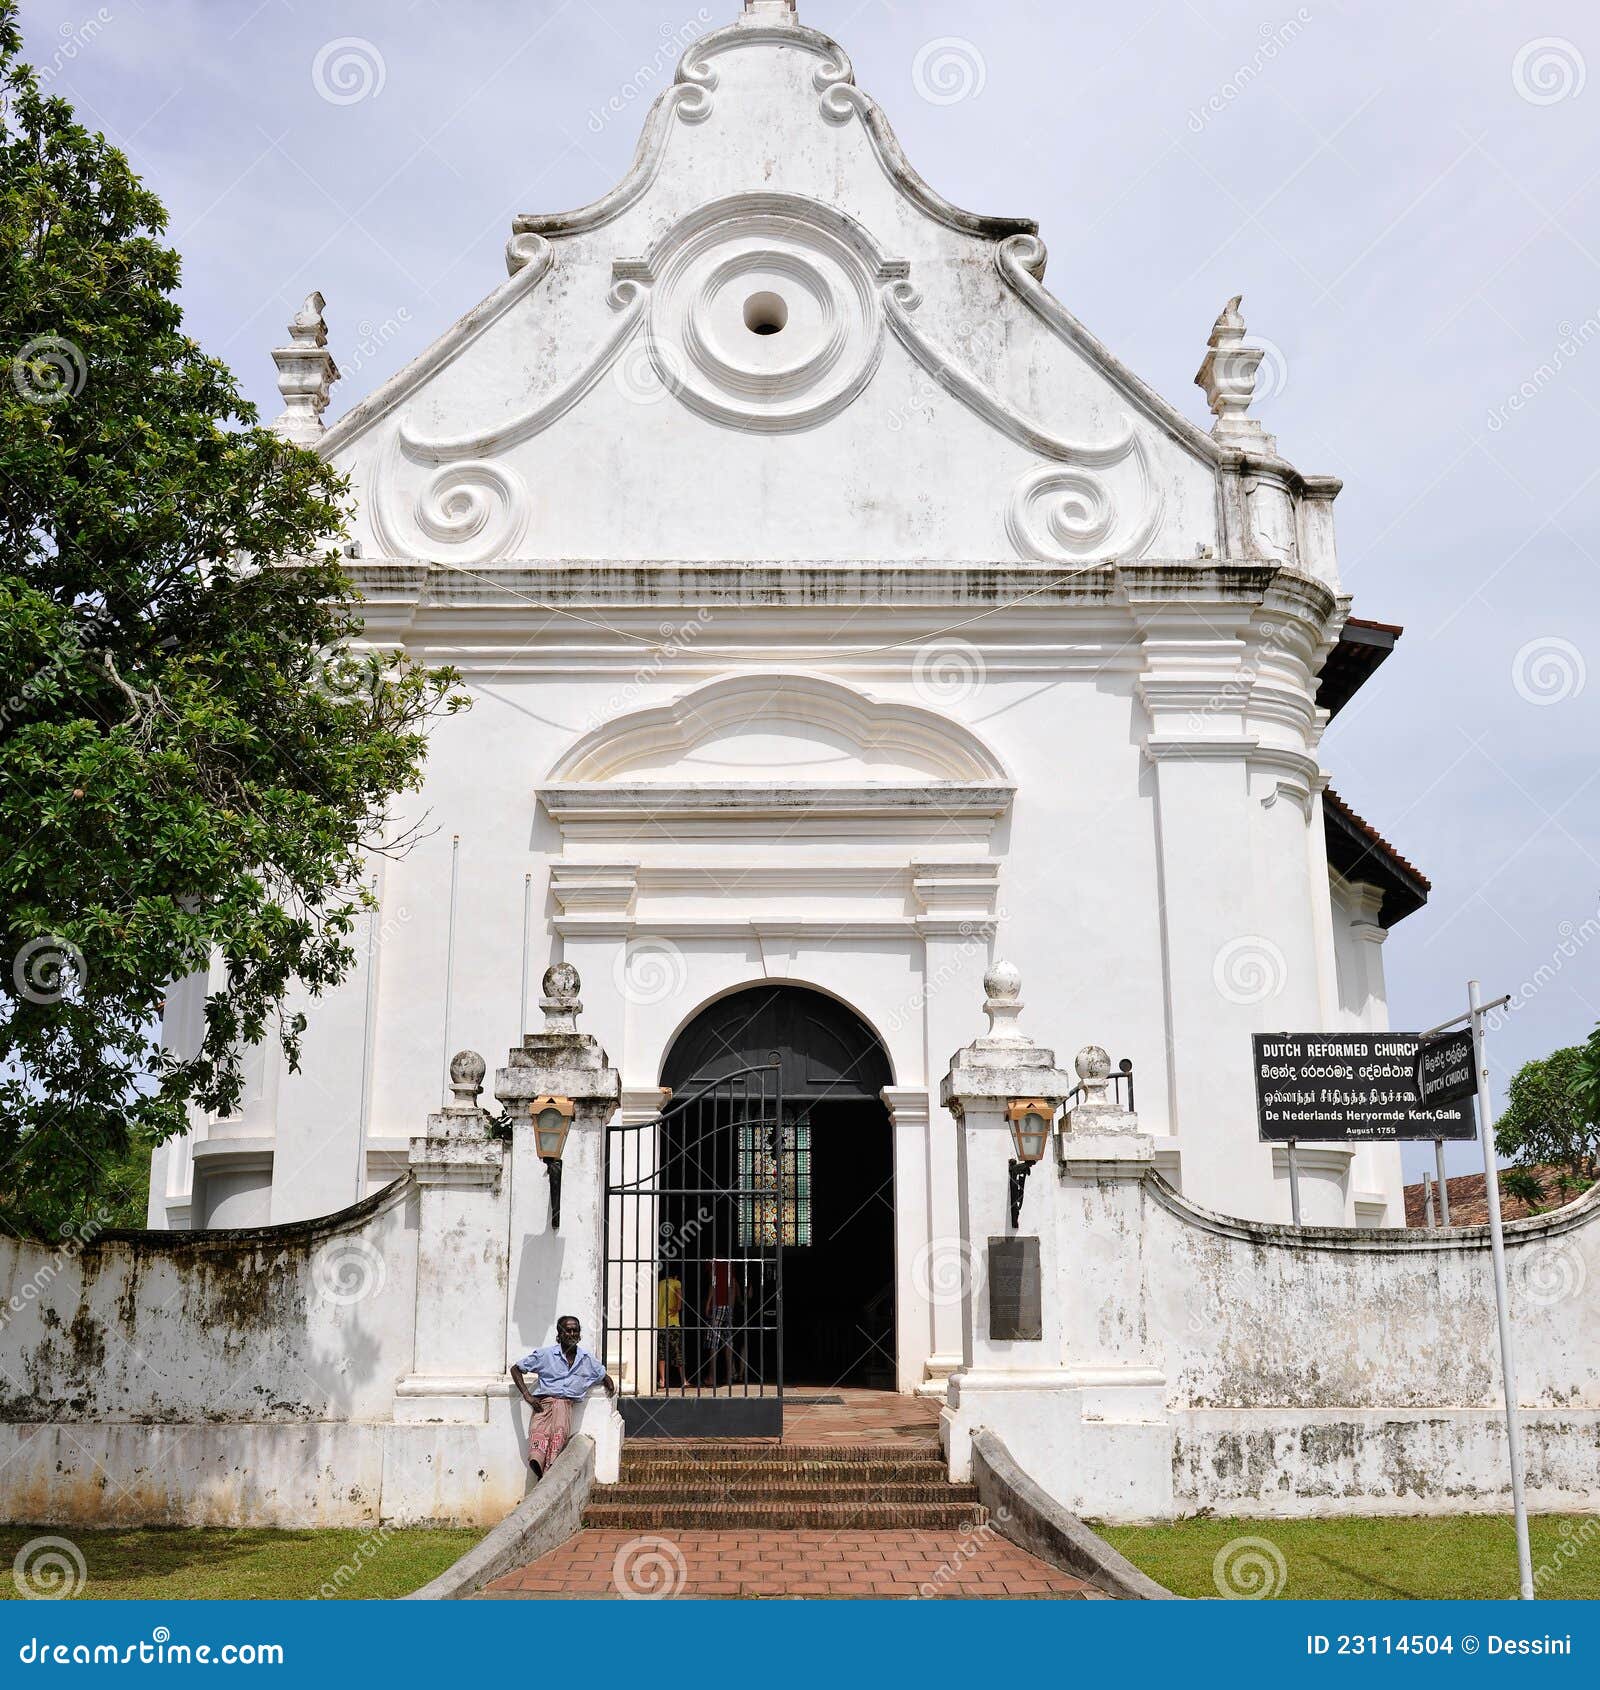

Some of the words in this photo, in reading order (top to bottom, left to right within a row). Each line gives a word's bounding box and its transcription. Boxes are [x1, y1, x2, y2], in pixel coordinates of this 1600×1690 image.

[1263, 1043, 1301, 1057] DUTCH
[1307, 1043, 1368, 1057] REFORMED
[1374, 1043, 1419, 1057] CHURCH
[1426, 1076, 1444, 1095] DUTCH
[1445, 1066, 1469, 1087] CHURCH
[1265, 1110, 1280, 1121] De
[1282, 1110, 1343, 1121] Nederlands
[1346, 1127, 1374, 1135] August
[1376, 1127, 1396, 1135] 1755
